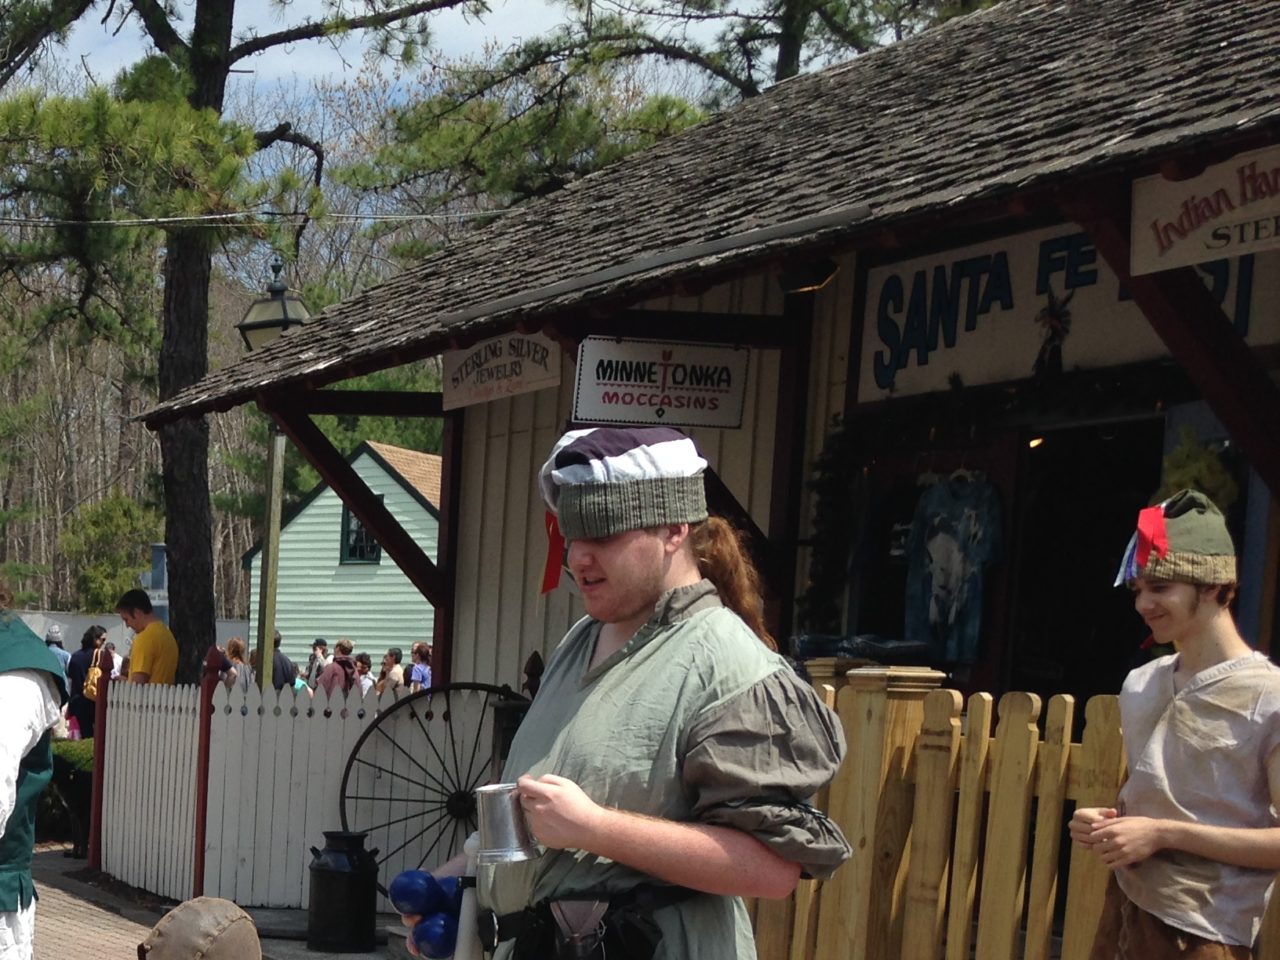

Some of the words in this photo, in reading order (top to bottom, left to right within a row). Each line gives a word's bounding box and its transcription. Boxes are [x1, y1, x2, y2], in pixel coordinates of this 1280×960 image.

[1150, 188, 1237, 257] Indian
[873, 251, 1015, 390] SANTA
[1035, 232, 1098, 297] FE
[451, 340, 503, 389] STERLING
[508, 338, 549, 372] SILVER
[473, 360, 522, 385] JEWELRY
[596, 353, 731, 392] MINNETONKA
[602, 391, 719, 411] MOCCASINS
